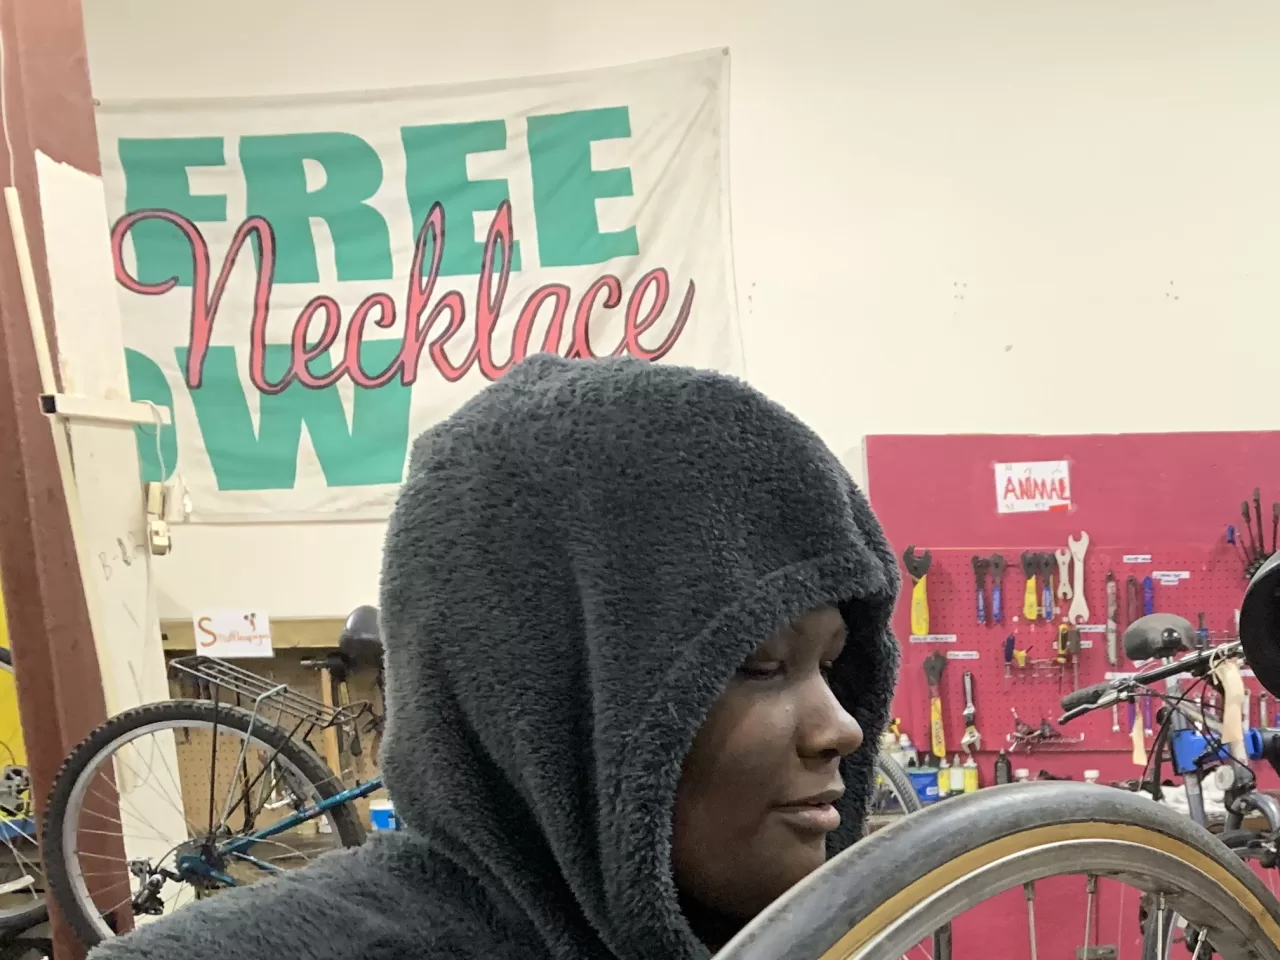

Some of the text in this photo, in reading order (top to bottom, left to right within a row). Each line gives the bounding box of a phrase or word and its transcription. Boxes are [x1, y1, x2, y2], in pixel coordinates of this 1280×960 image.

[118, 106, 640, 287] FREE
[111, 199, 695, 395] Necklace
[1003, 475, 1071, 501] ANIMAL
